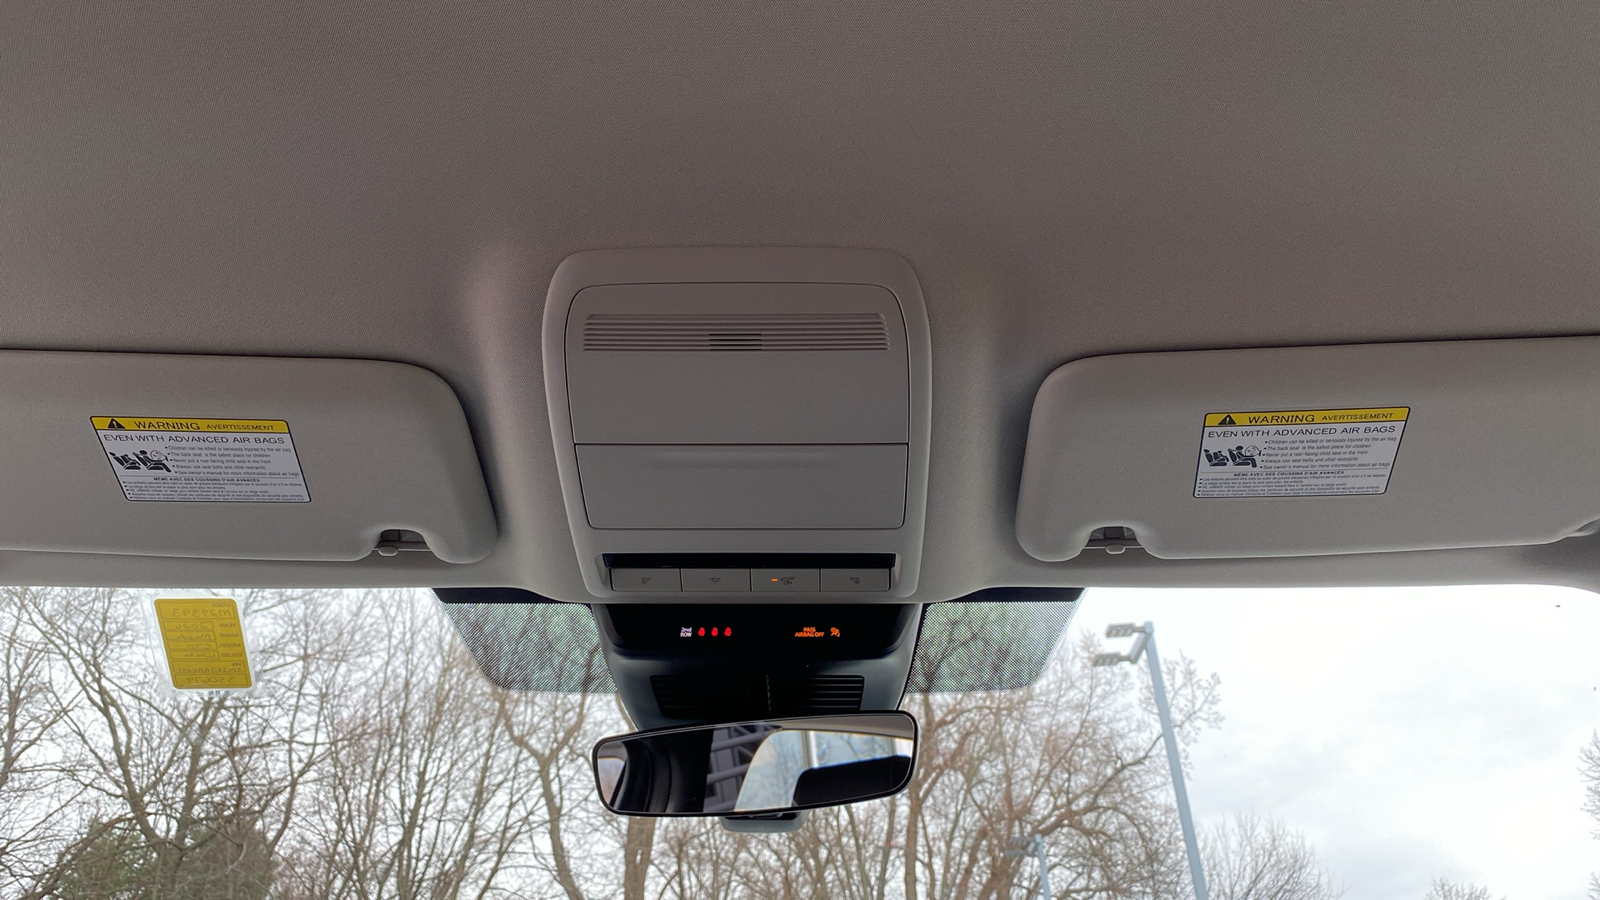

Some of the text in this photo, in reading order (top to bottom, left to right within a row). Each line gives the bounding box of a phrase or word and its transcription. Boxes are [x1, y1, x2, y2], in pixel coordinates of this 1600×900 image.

[1248, 413, 1394, 423] WARNING AVERTISSEMENT
[134, 421, 200, 430] WARNING
[1273, 428, 1337, 436] ADVANCED
